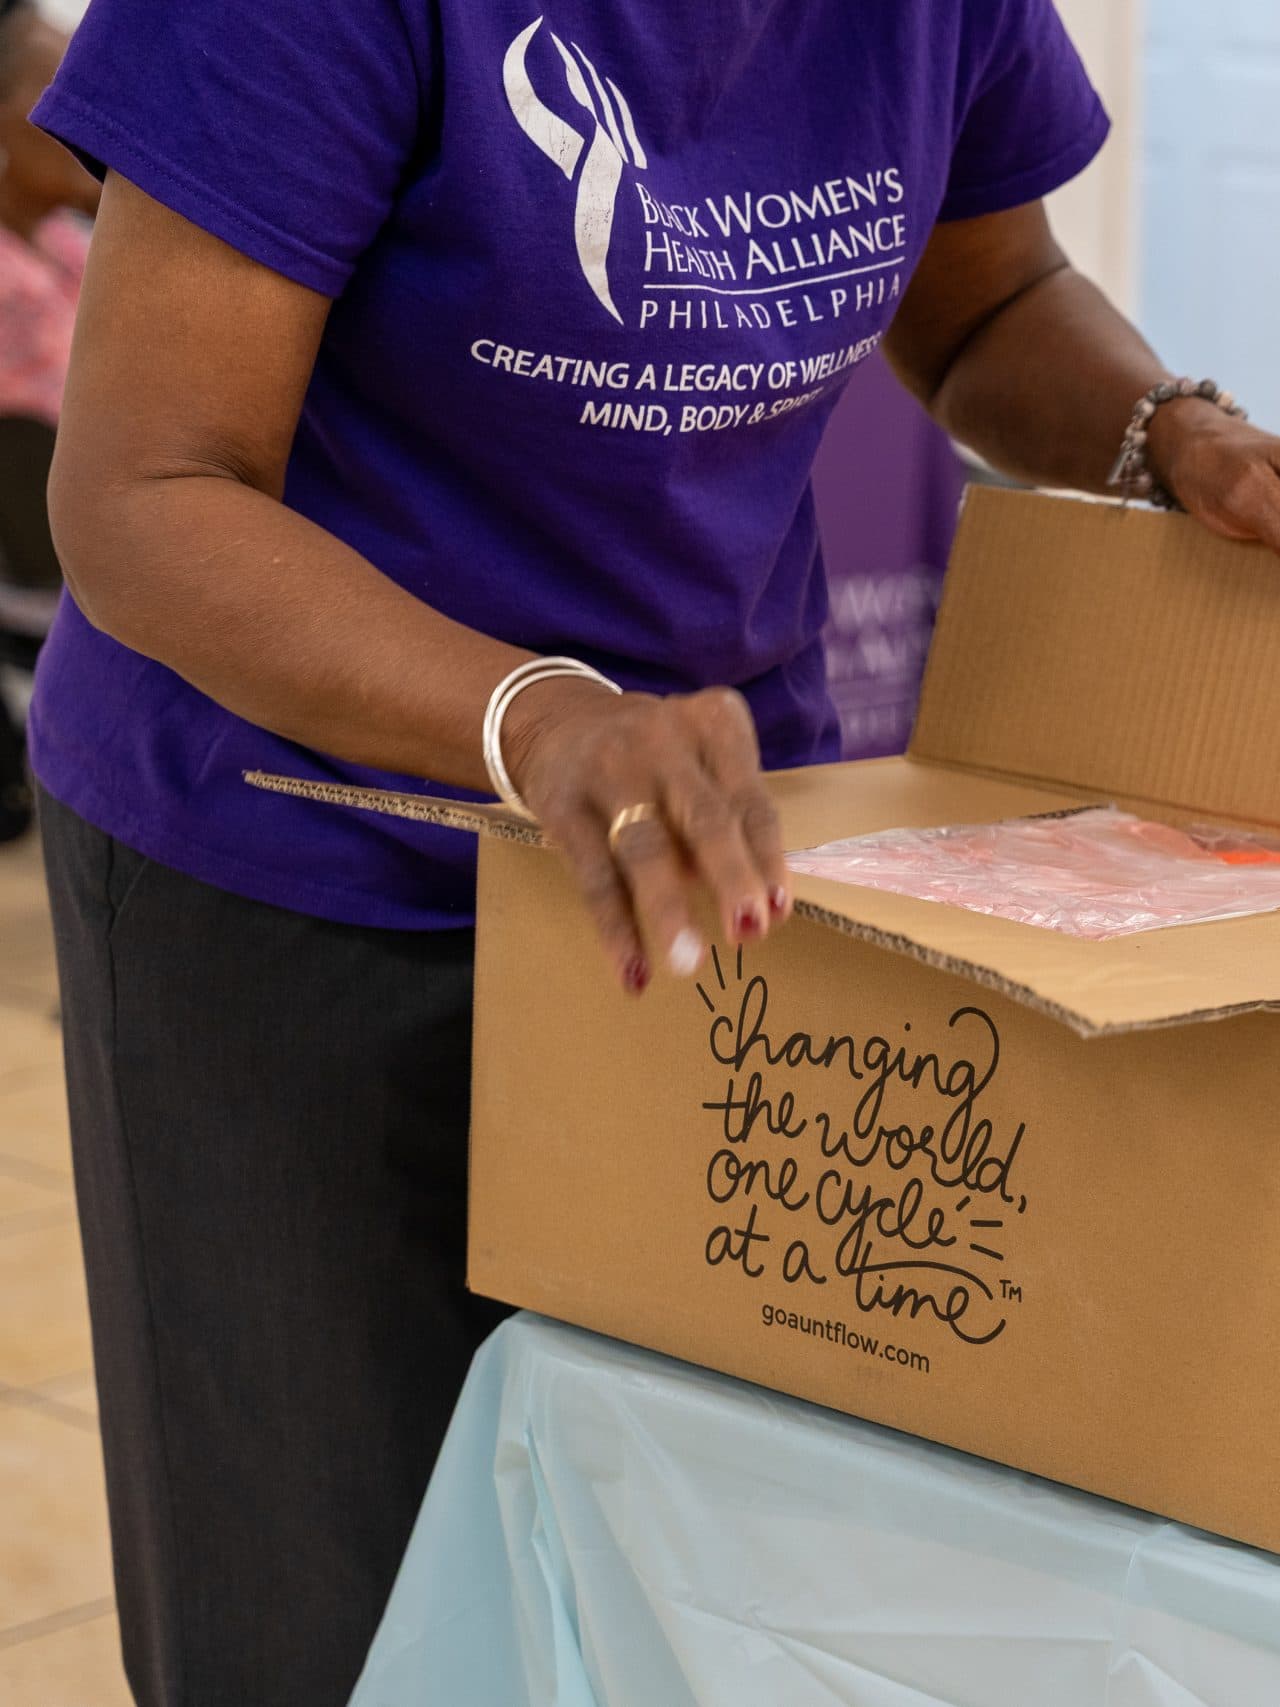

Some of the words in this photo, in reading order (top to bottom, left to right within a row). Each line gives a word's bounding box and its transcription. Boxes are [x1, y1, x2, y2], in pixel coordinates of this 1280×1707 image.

[635, 182, 709, 238] BLACK
[705, 168, 904, 237] WOMEN'S
[644, 231, 737, 280] HEALTH
[746, 214, 906, 280] ALLIANCE
[640, 272, 900, 329] PHILADELPHIA
[470, 339, 630, 389] CREATING
[634, 363, 657, 391] A
[663, 363, 764, 391] LEGACY
[768, 361, 797, 390] OF
[580, 401, 673, 436] MIND,
[679, 403, 749, 432] BODY
[746, 402, 766, 424] &
[710, 975, 1000, 1164] changing
[702, 1071, 806, 1143] the
[706, 1149, 810, 1212] one
[816, 1169, 958, 1276] cycle
[705, 1204, 770, 1277] at
[783, 1240, 827, 1285] a
[848, 1241, 1007, 1345] time
[762, 1303, 931, 1374] goauntflow.com
